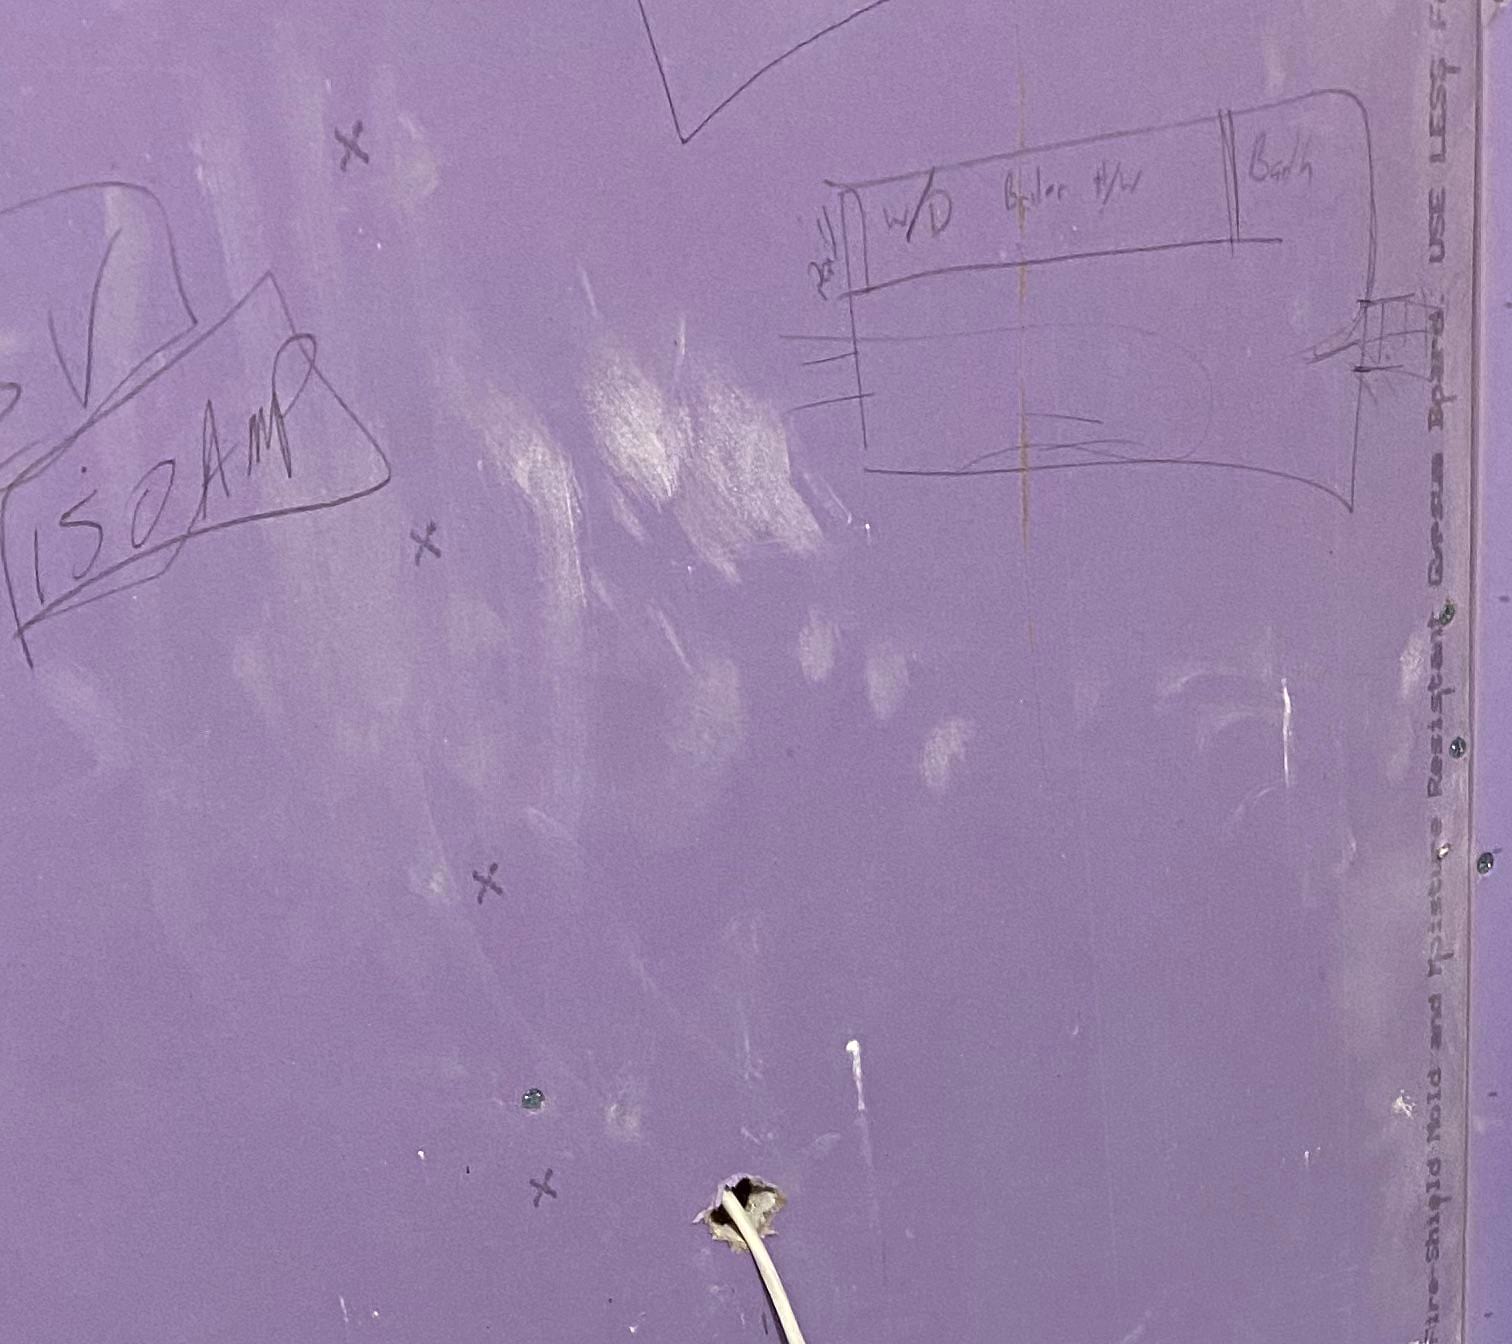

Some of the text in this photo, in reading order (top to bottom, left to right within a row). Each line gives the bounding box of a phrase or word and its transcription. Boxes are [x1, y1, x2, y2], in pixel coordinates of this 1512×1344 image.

[1428, 56, 1449, 165] LESS
[1427, 188, 1446, 265] USE
[1426, 612, 1446, 798] Resistant
[1426, 993, 1444, 1051] and
[1426, 1066, 1444, 1145] Mold
